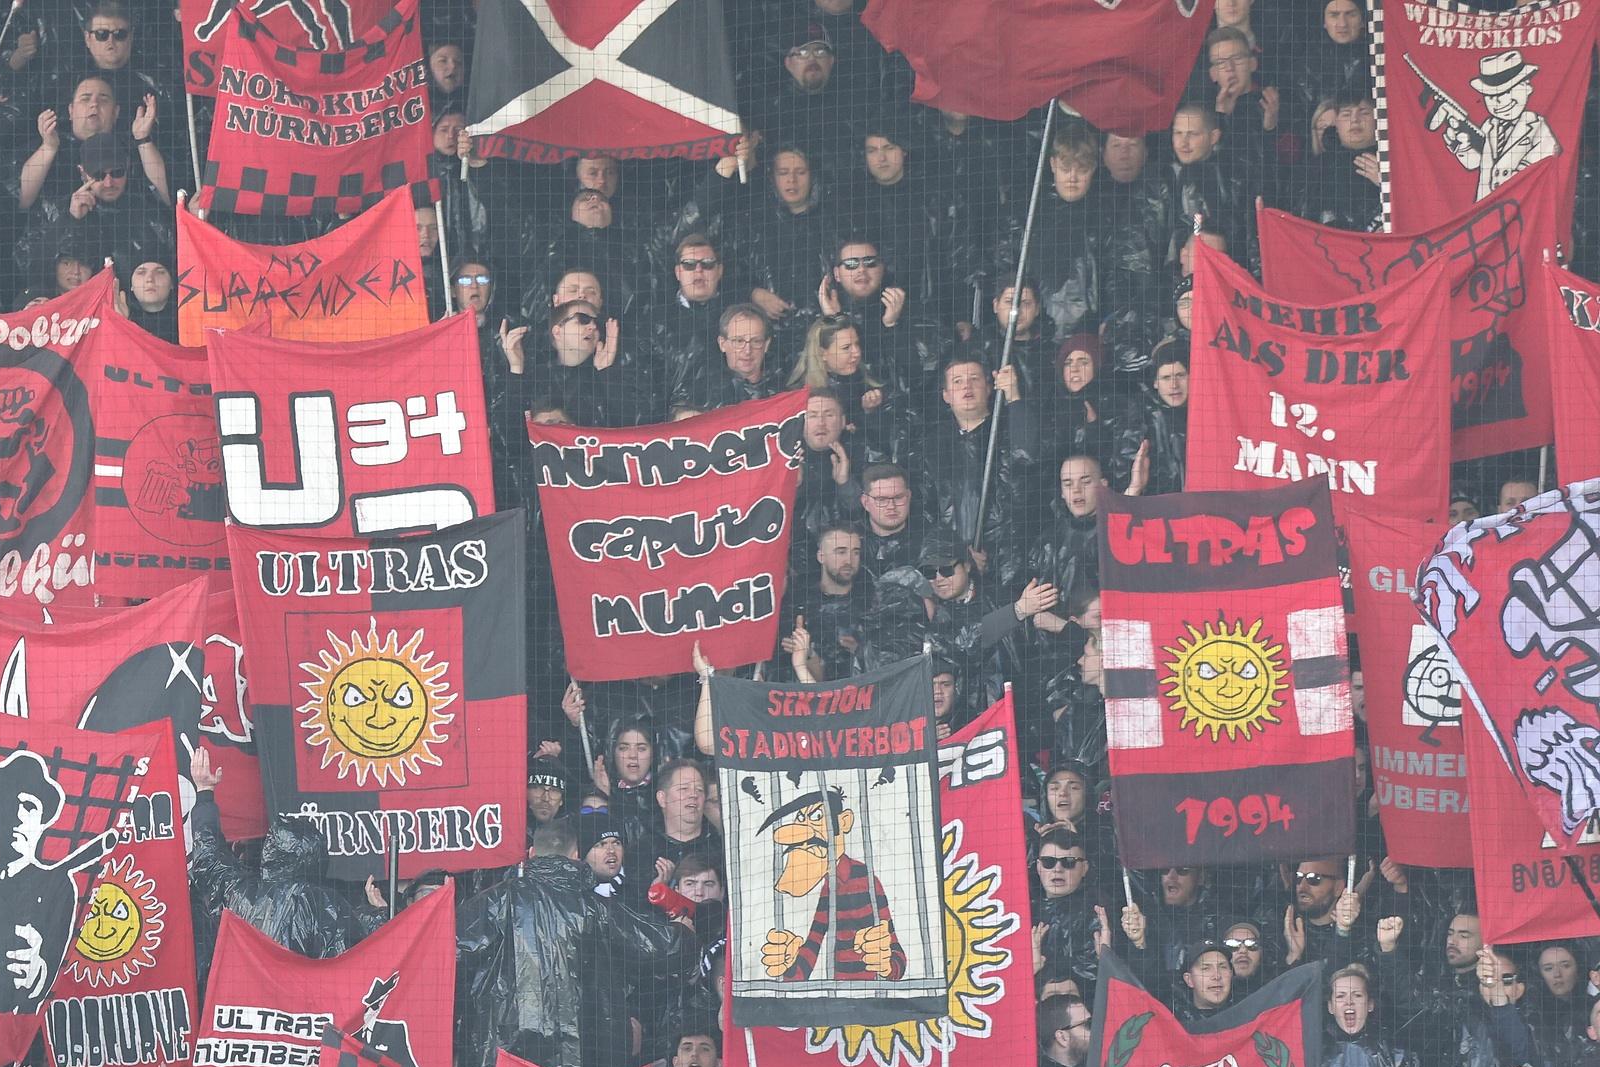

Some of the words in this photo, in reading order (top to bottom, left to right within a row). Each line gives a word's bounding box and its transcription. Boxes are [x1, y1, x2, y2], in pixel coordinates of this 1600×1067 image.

[1403, 1, 1581, 30] WIDERSTAND
[1419, 24, 1562, 49] ZWECKLOS
[219, 58, 428, 117] NORDKURVE
[226, 97, 426, 147] NÜRNBERG
[1231, 288, 1383, 337] MEHR
[1303, 347, 1411, 387] DER
[1106, 507, 1317, 566] ULTRAS
[256, 539, 488, 596] ULTRAS
[767, 683, 875, 718] SEKTION
[718, 715, 928, 761] STADIONVERBOT
[279, 802, 503, 856] RNBERG
[1174, 794, 1296, 846] 1994
